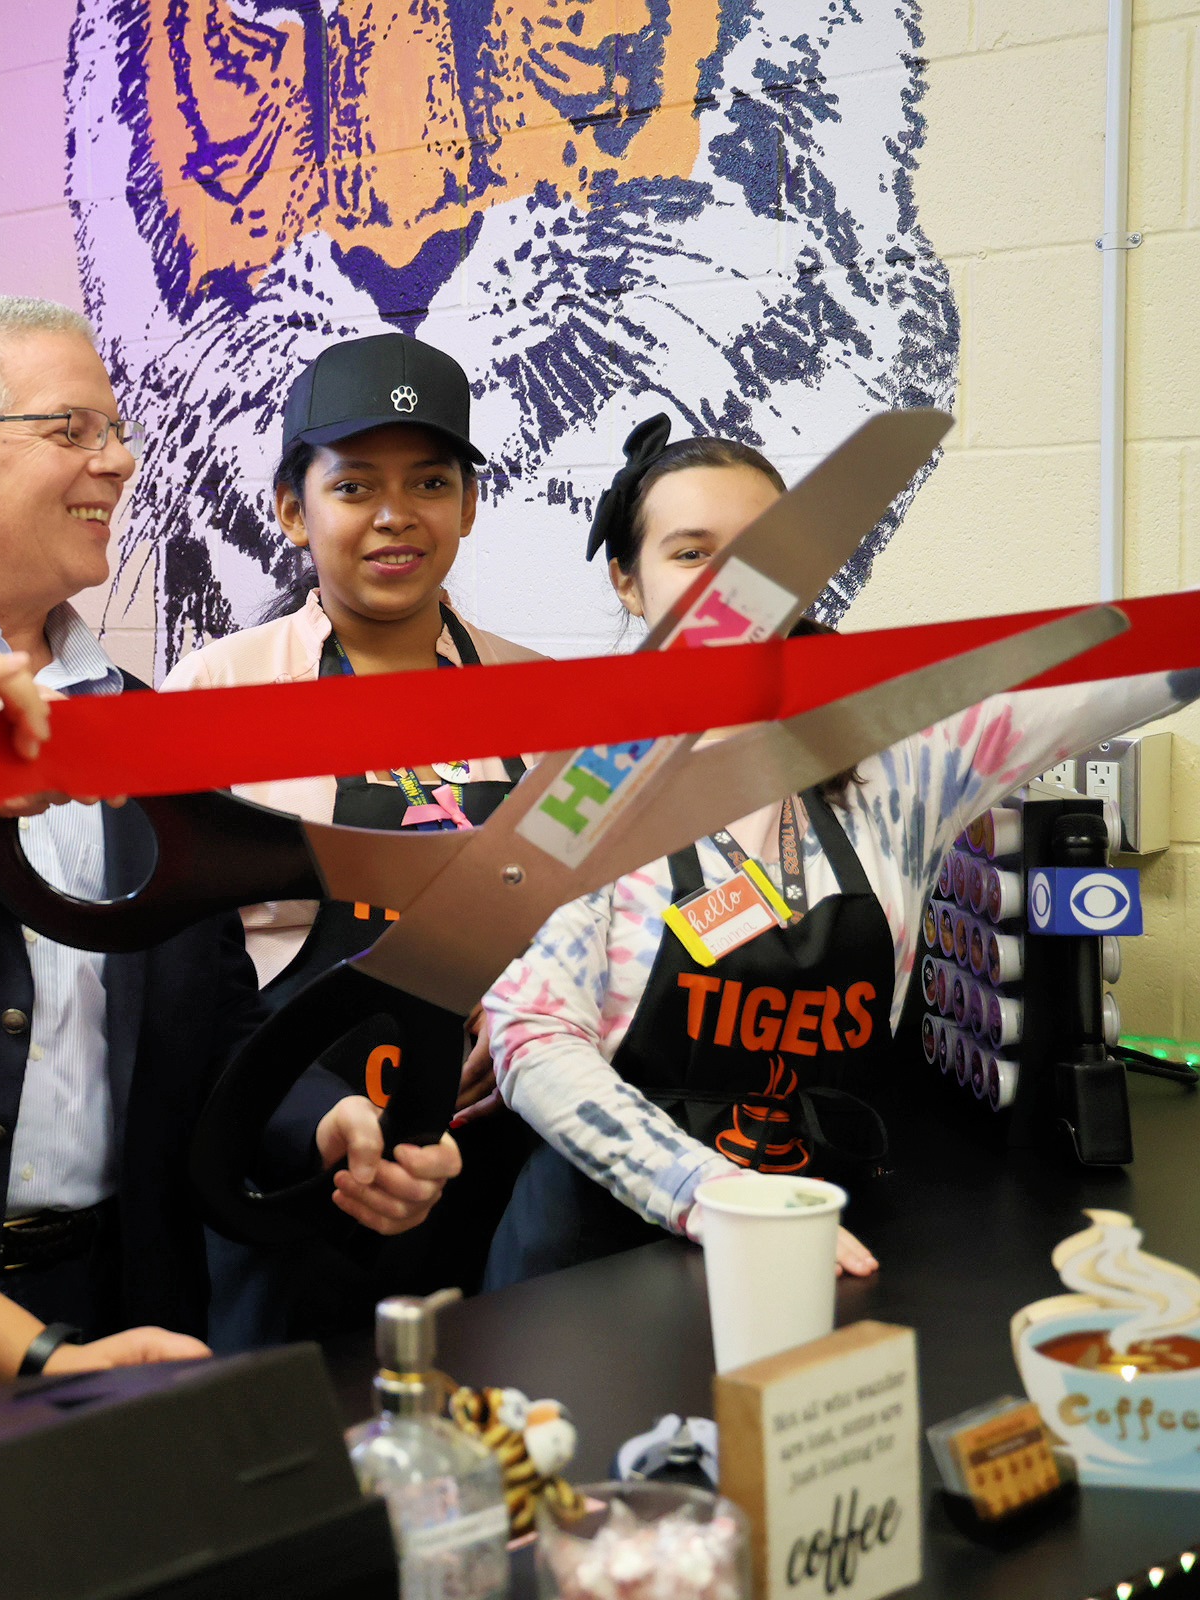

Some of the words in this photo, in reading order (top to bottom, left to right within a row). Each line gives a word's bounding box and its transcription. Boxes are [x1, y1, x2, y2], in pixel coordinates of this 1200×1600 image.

[781, 826, 800, 875] TIGERS
[687, 888, 742, 933] hello
[676, 972, 877, 1057] TIGERS
[1057, 1392, 1200, 1441] Coffee
[785, 1487, 904, 1595] coffee
